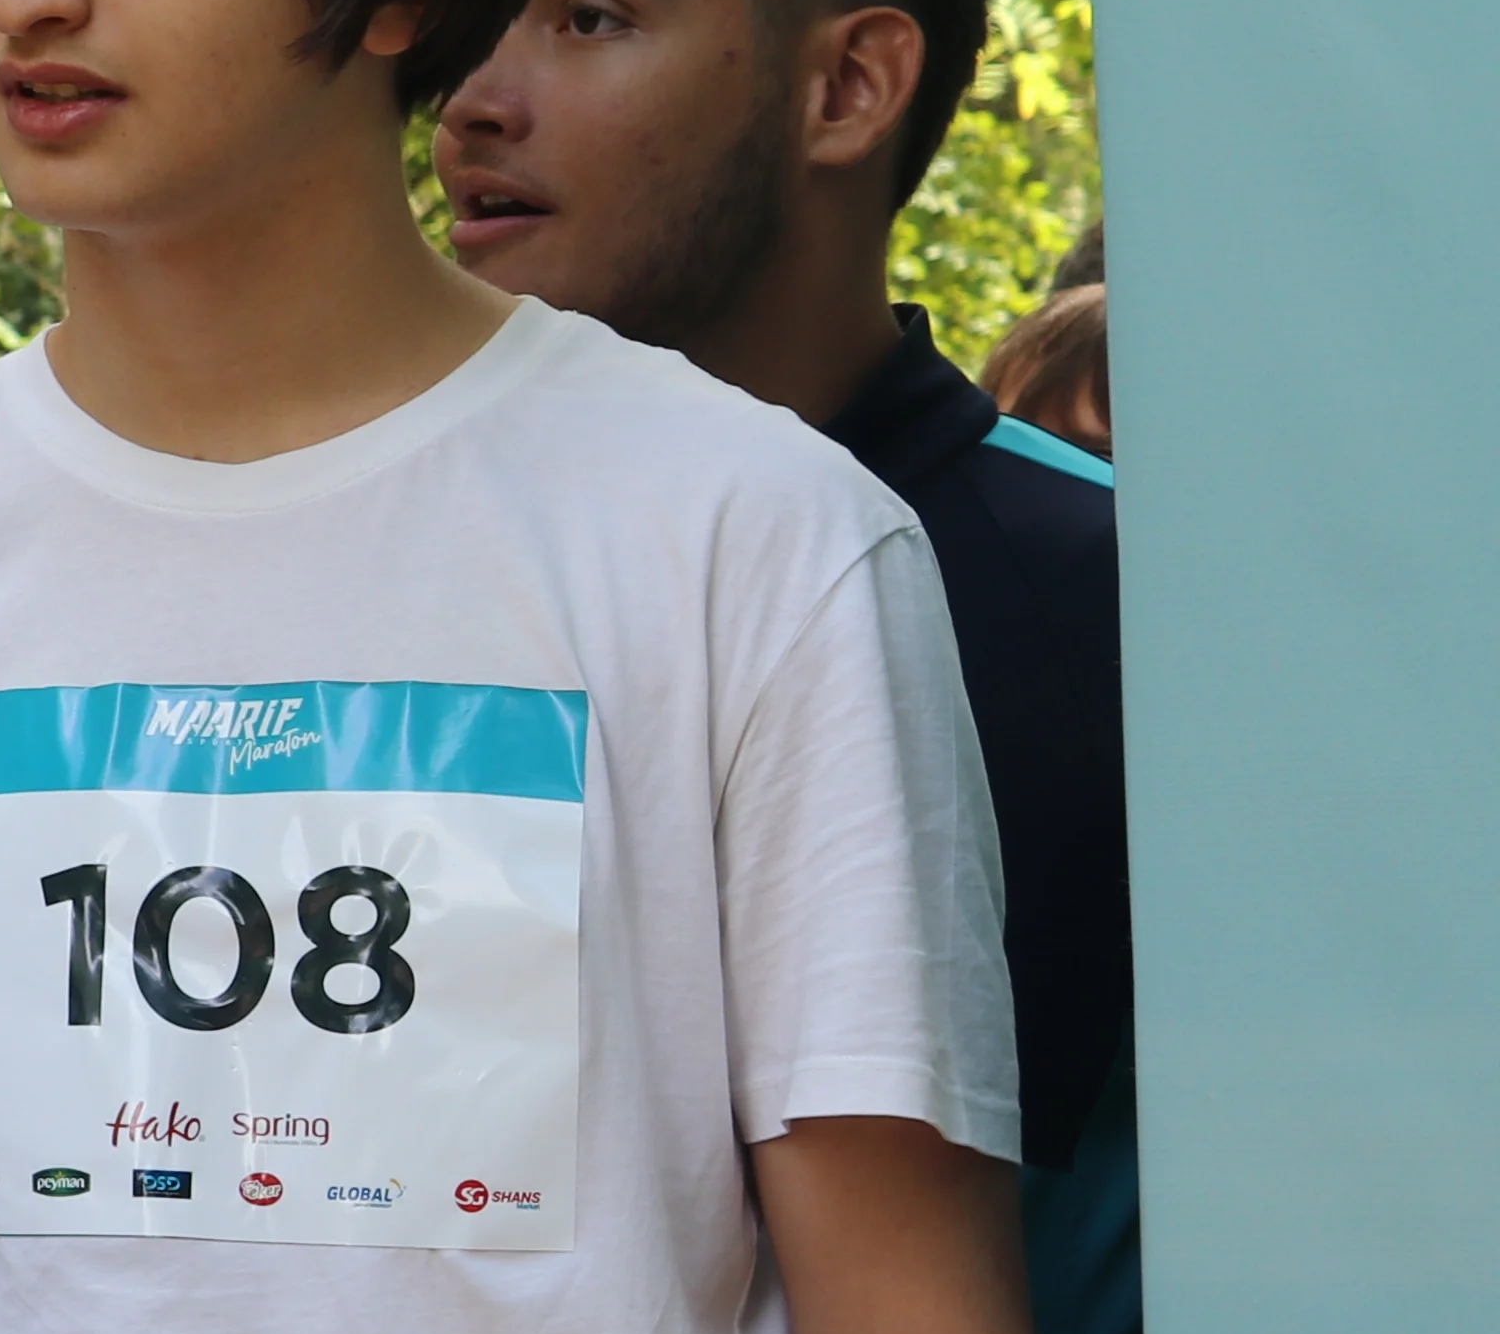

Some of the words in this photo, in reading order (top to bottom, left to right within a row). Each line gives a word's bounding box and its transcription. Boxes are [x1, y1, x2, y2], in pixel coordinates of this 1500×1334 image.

[146, 698, 303, 745] MAARIF
[229, 728, 322, 776] Maraton
[40, 863, 416, 1035] 108
[106, 1101, 201, 1147] Hako
[232, 1113, 330, 1146] Spring
[37, 1176, 85, 1191] peyman
[143, 1175, 181, 1191] DSD
[327, 1185, 393, 1202] GLOBAL
[491, 1191, 541, 1203] SHANS
